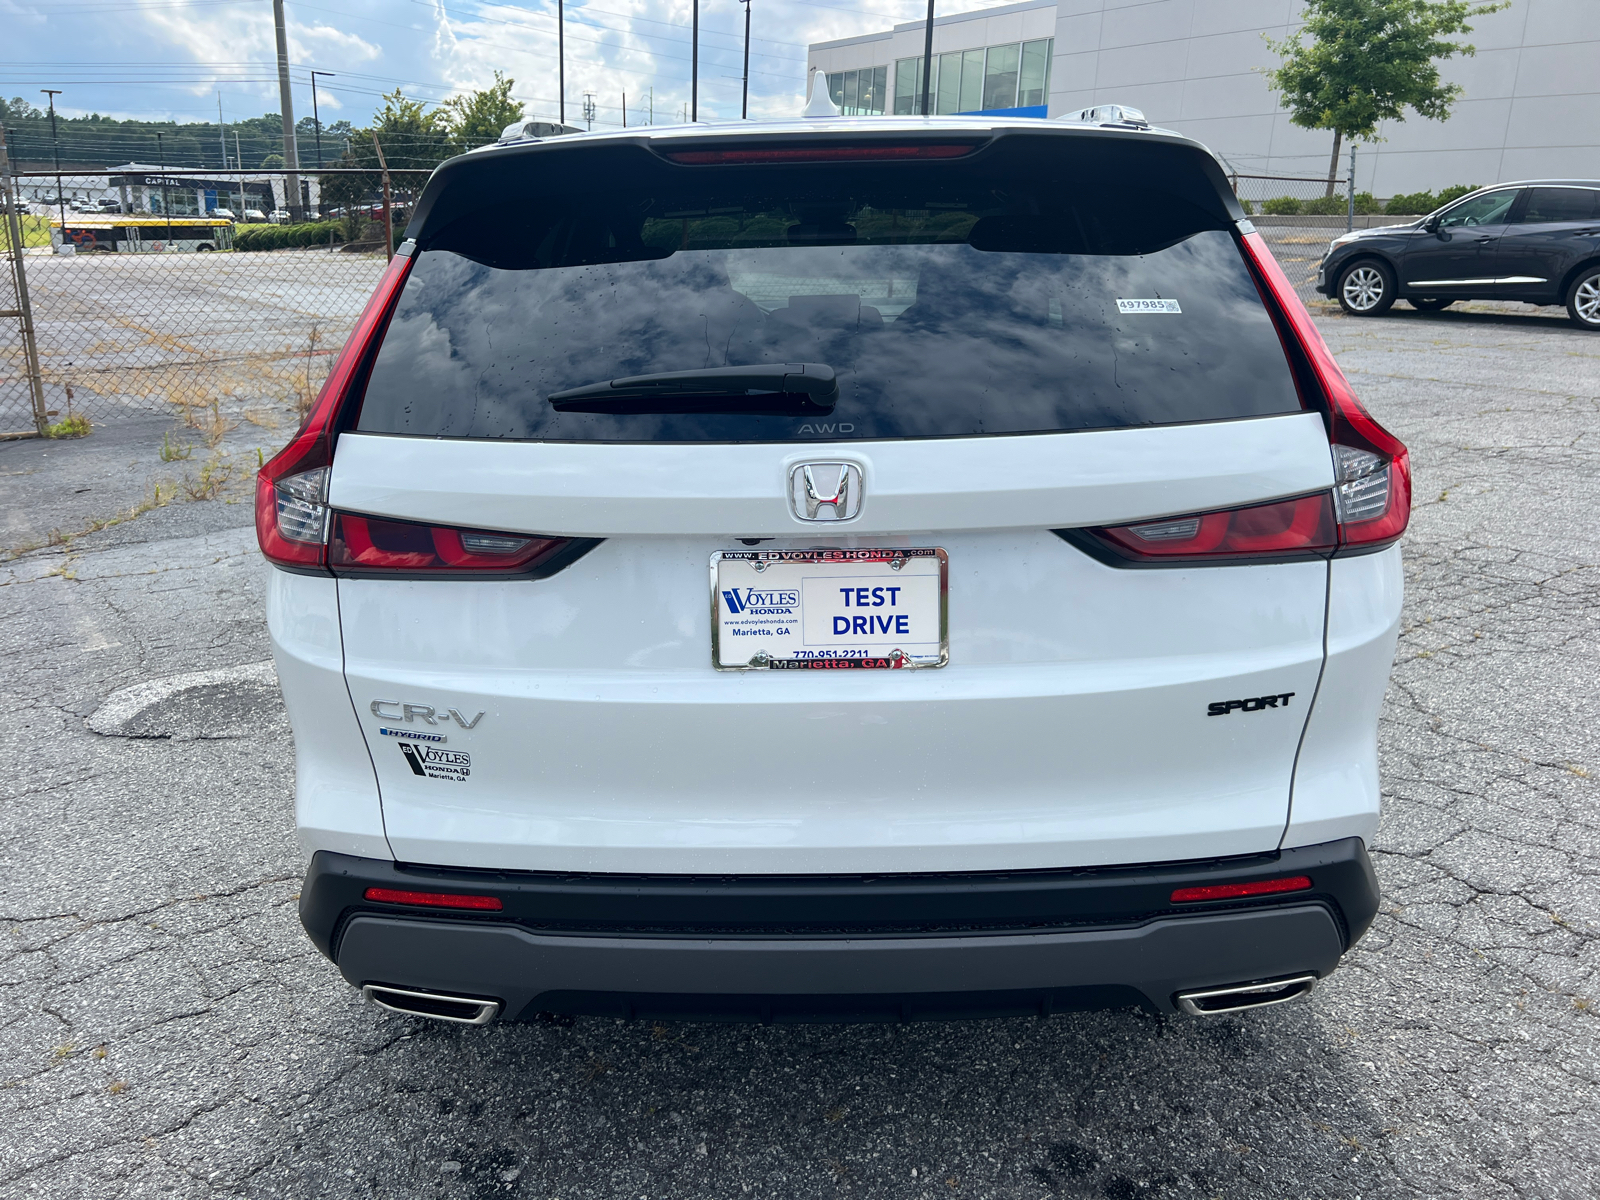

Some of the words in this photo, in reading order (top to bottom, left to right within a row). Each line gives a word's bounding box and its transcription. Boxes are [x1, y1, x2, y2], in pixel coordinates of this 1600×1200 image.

[1119, 300, 1166, 309] 497985
[797, 423, 855, 434] AWD
[731, 587, 797, 612] VOYLES
[839, 586, 902, 607] TEST
[832, 615, 910, 635] DRIVE
[732, 628, 774, 637] Marietta,
[776, 627, 791, 636] GA
[792, 650, 869, 658] 770-951-2211
[772, 659, 855, 670] Marietta,
[861, 658, 888, 668] GA
[1207, 692, 1296, 716] SPORT
[370, 698, 486, 730] CR-V
[387, 729, 442, 743] HYBRID
[402, 746, 413, 755] ED
[412, 743, 470, 766] VOYLES
[424, 764, 460, 774] HONDA
[428, 772, 456, 782] Marietta,
[456, 775, 467, 783] GA
